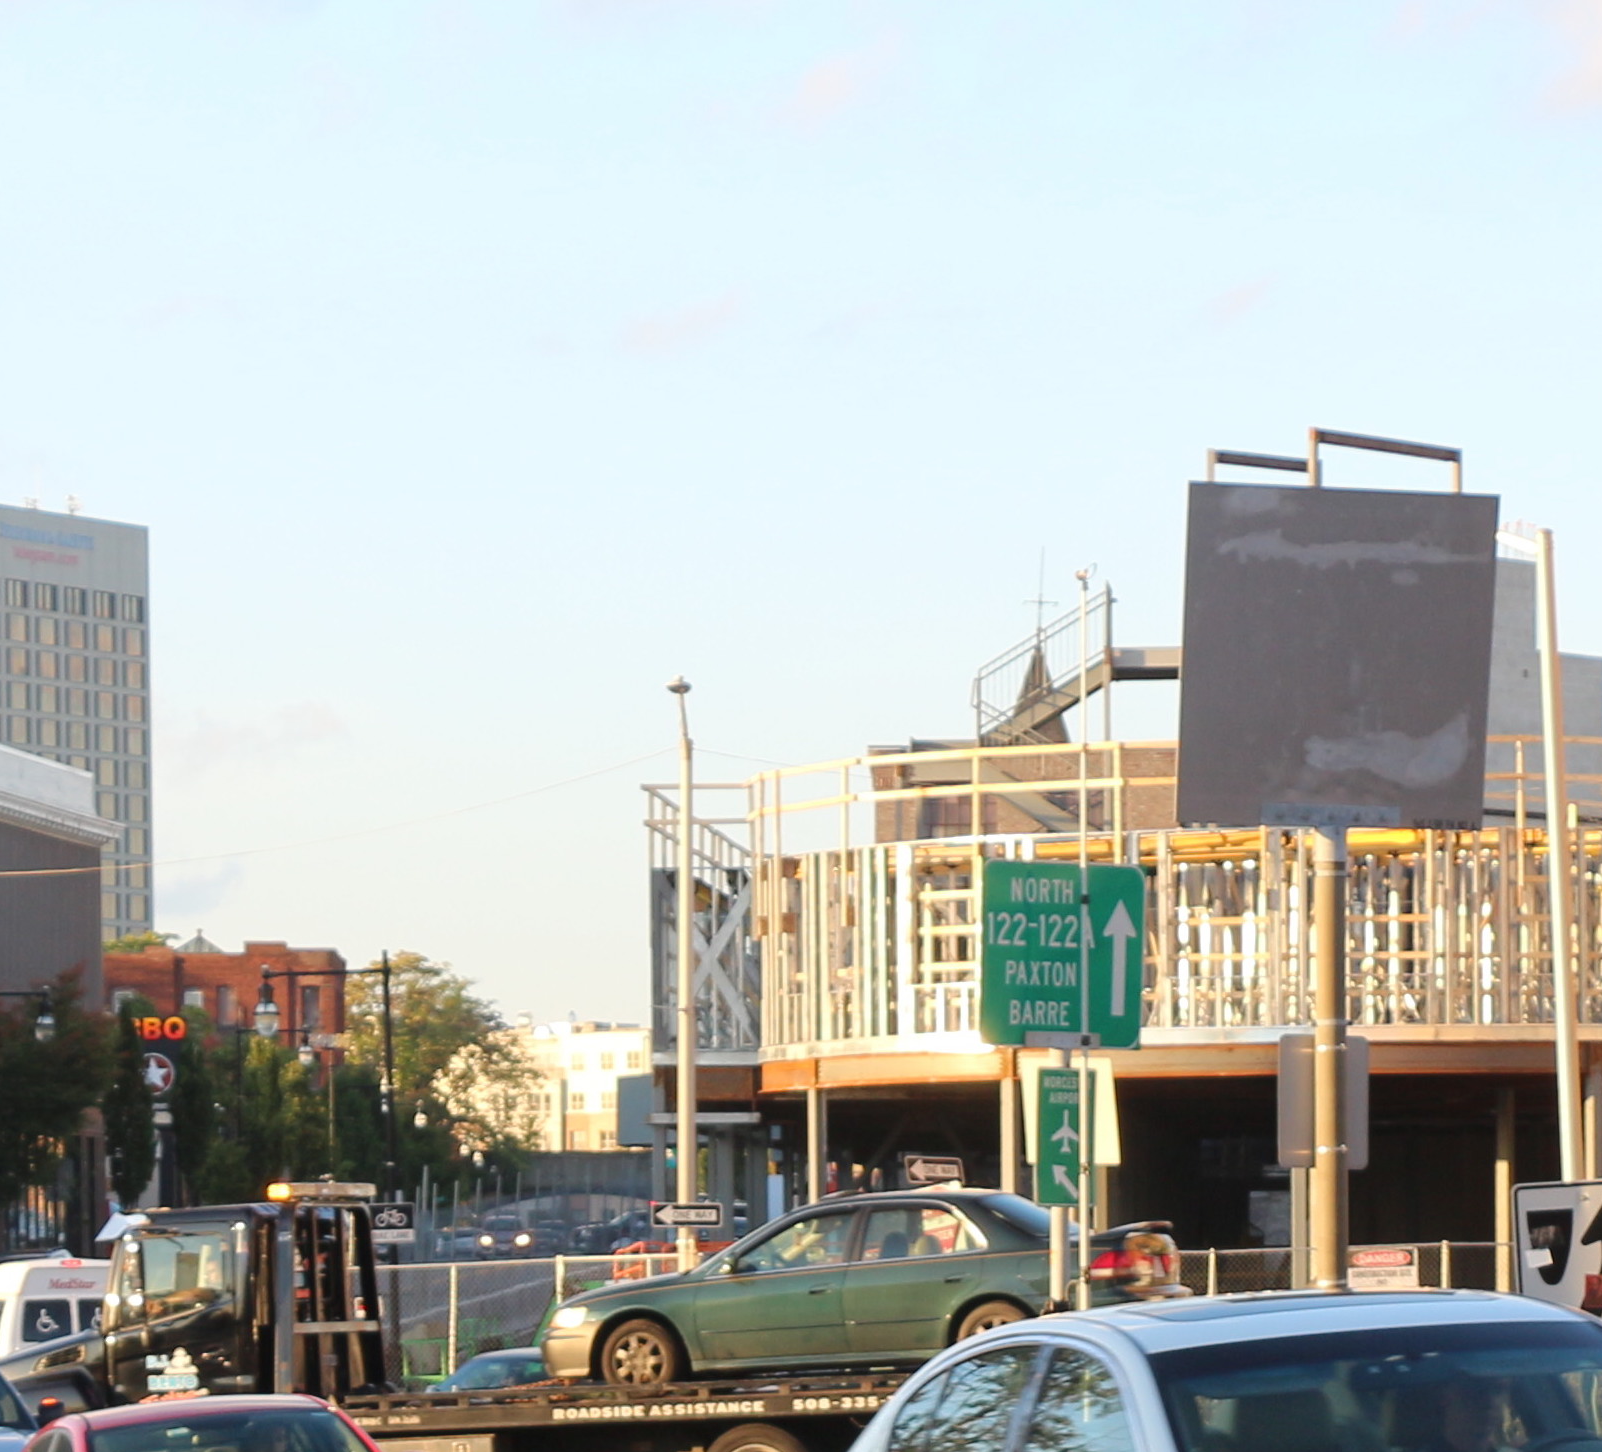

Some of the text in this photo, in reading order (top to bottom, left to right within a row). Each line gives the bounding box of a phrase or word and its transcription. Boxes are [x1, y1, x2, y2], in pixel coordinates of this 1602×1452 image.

[1011, 877, 1074, 904] NORTH
[1005, 960, 1078, 987] PAXTON
[1009, 1000, 1071, 1026] BARRE
[672, 1209, 714, 1220] ONE WAY
[1358, 1253, 1405, 1265] DANGER
[552, 1405, 646, 1420] ROADSIDE
[649, 1400, 765, 1417] ASSISTANCE
